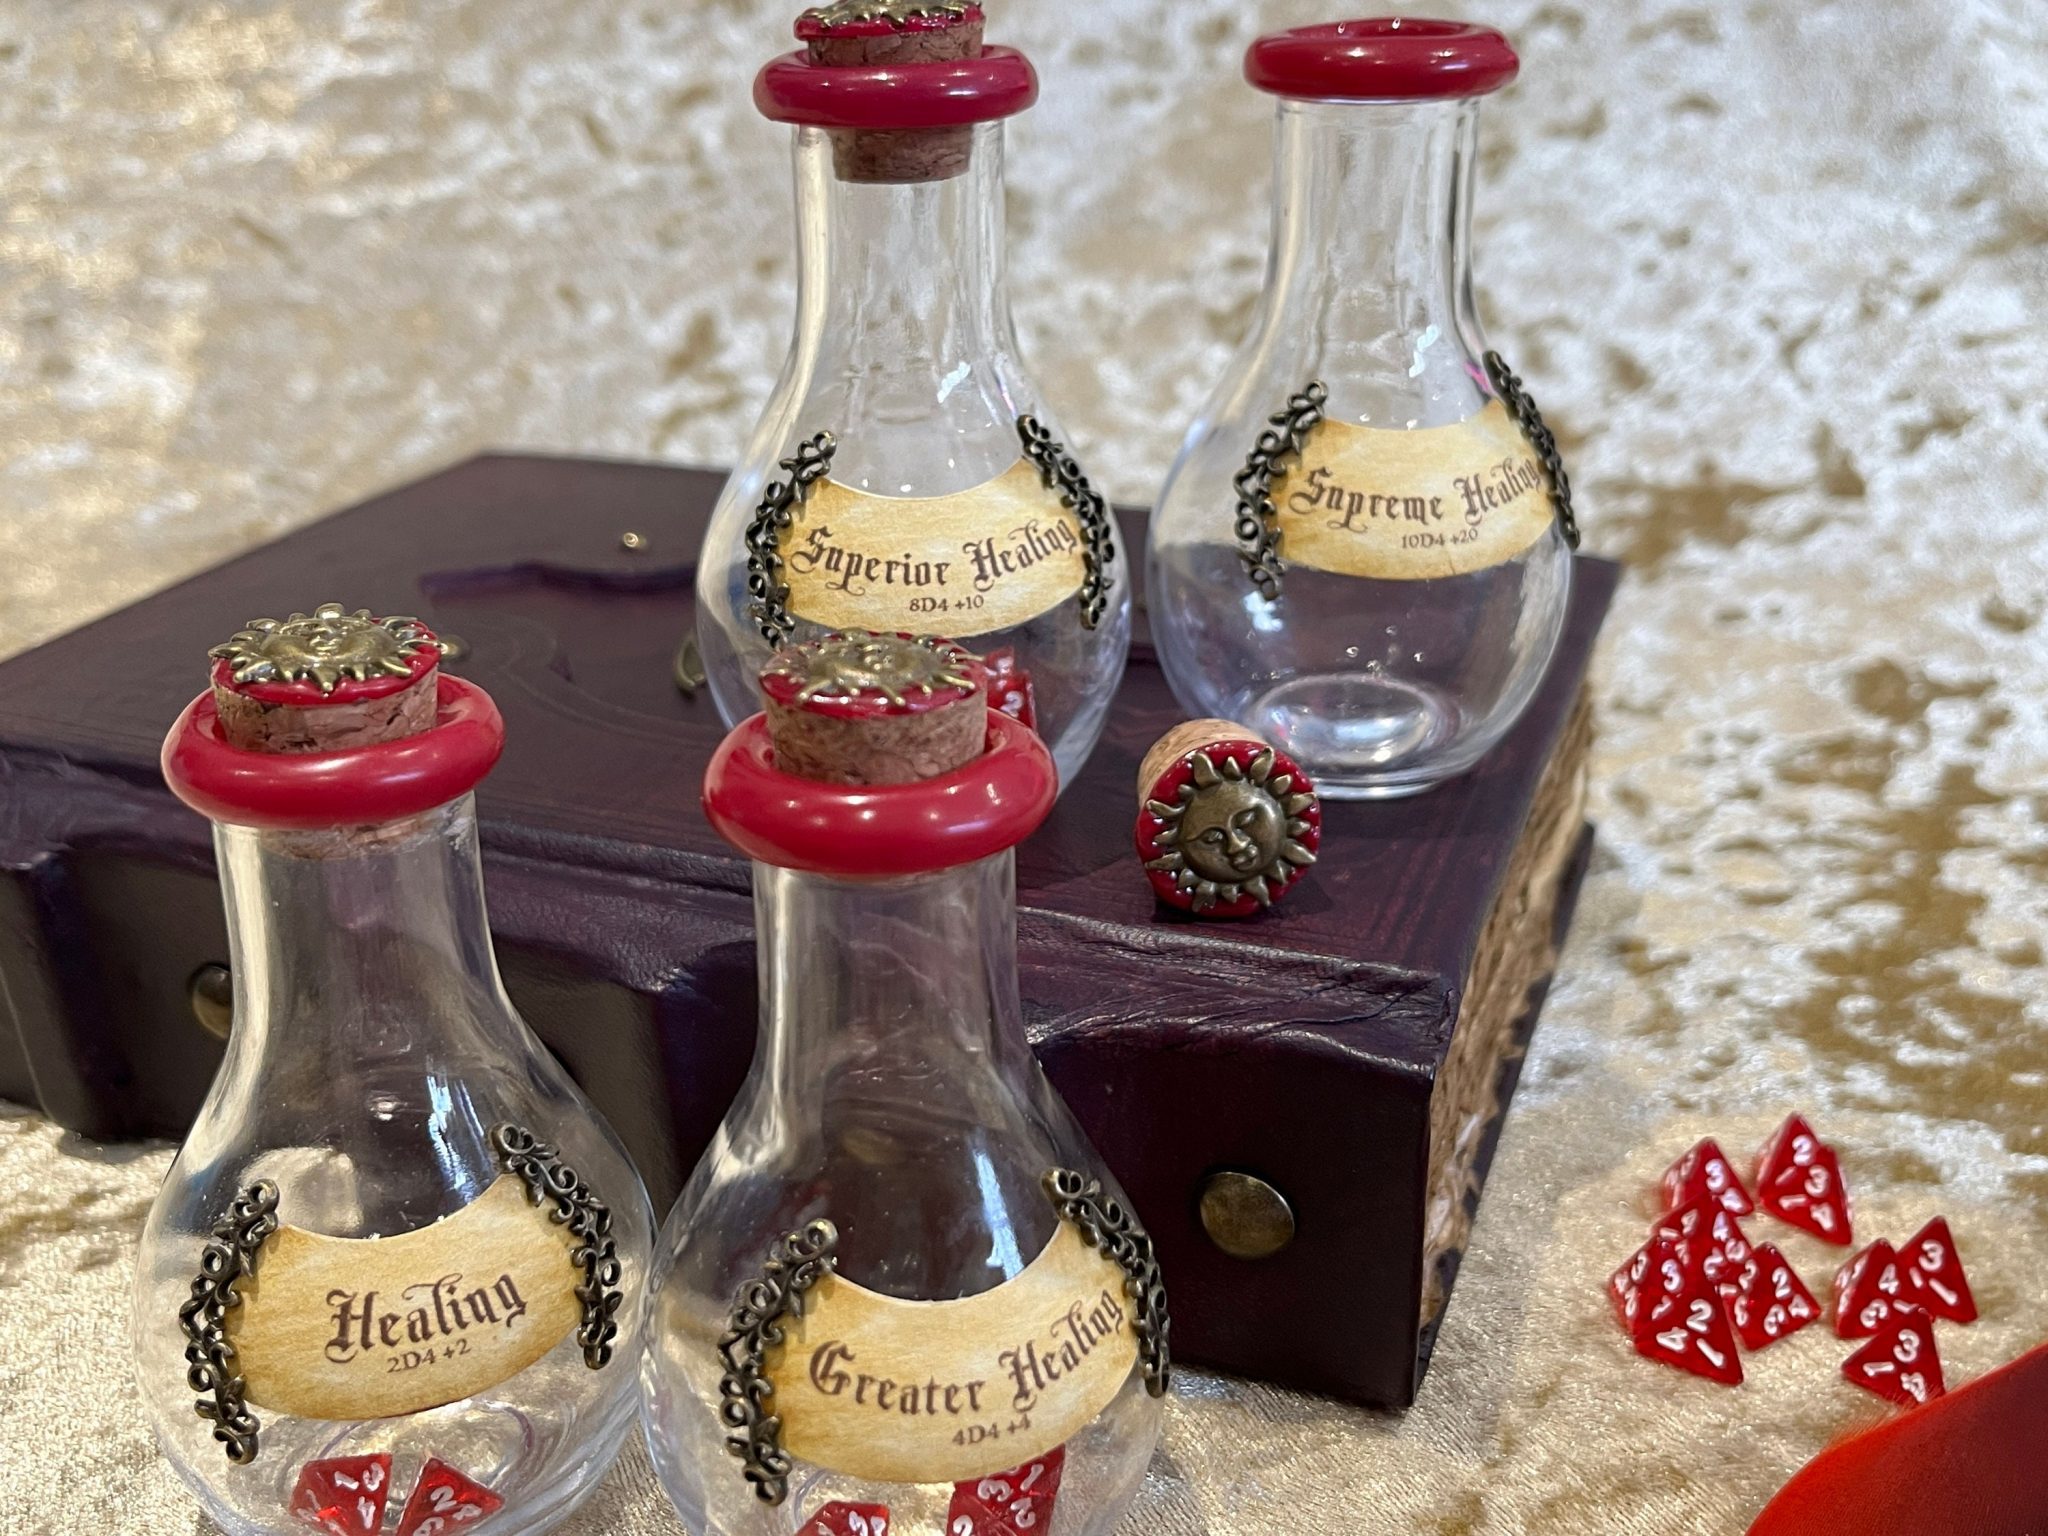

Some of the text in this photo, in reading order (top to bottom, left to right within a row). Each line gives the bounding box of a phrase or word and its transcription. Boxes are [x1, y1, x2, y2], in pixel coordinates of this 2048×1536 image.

[1288, 457, 1541, 534] Supreme Healing
[1401, 528, 1479, 549] 10D4 +20
[790, 518, 1078, 596] Superior Healing
[908, 594, 985, 612] 8D4 +10
[1705, 1159, 1728, 1192] 3
[1804, 1165, 1829, 1198] 3
[1919, 1239, 1944, 1272] 3
[1772, 1266, 1792, 1299] 2
[1879, 1263, 1899, 1295] 4
[325, 1272, 528, 1363] Healing
[1686, 1299, 1712, 1333] 2
[387, 1338, 471, 1374] 2D4 +2
[809, 1289, 1124, 1416] Greater Healing
[1894, 1328, 1920, 1363] 3
[952, 1414, 1032, 1447] 4D4 +4
